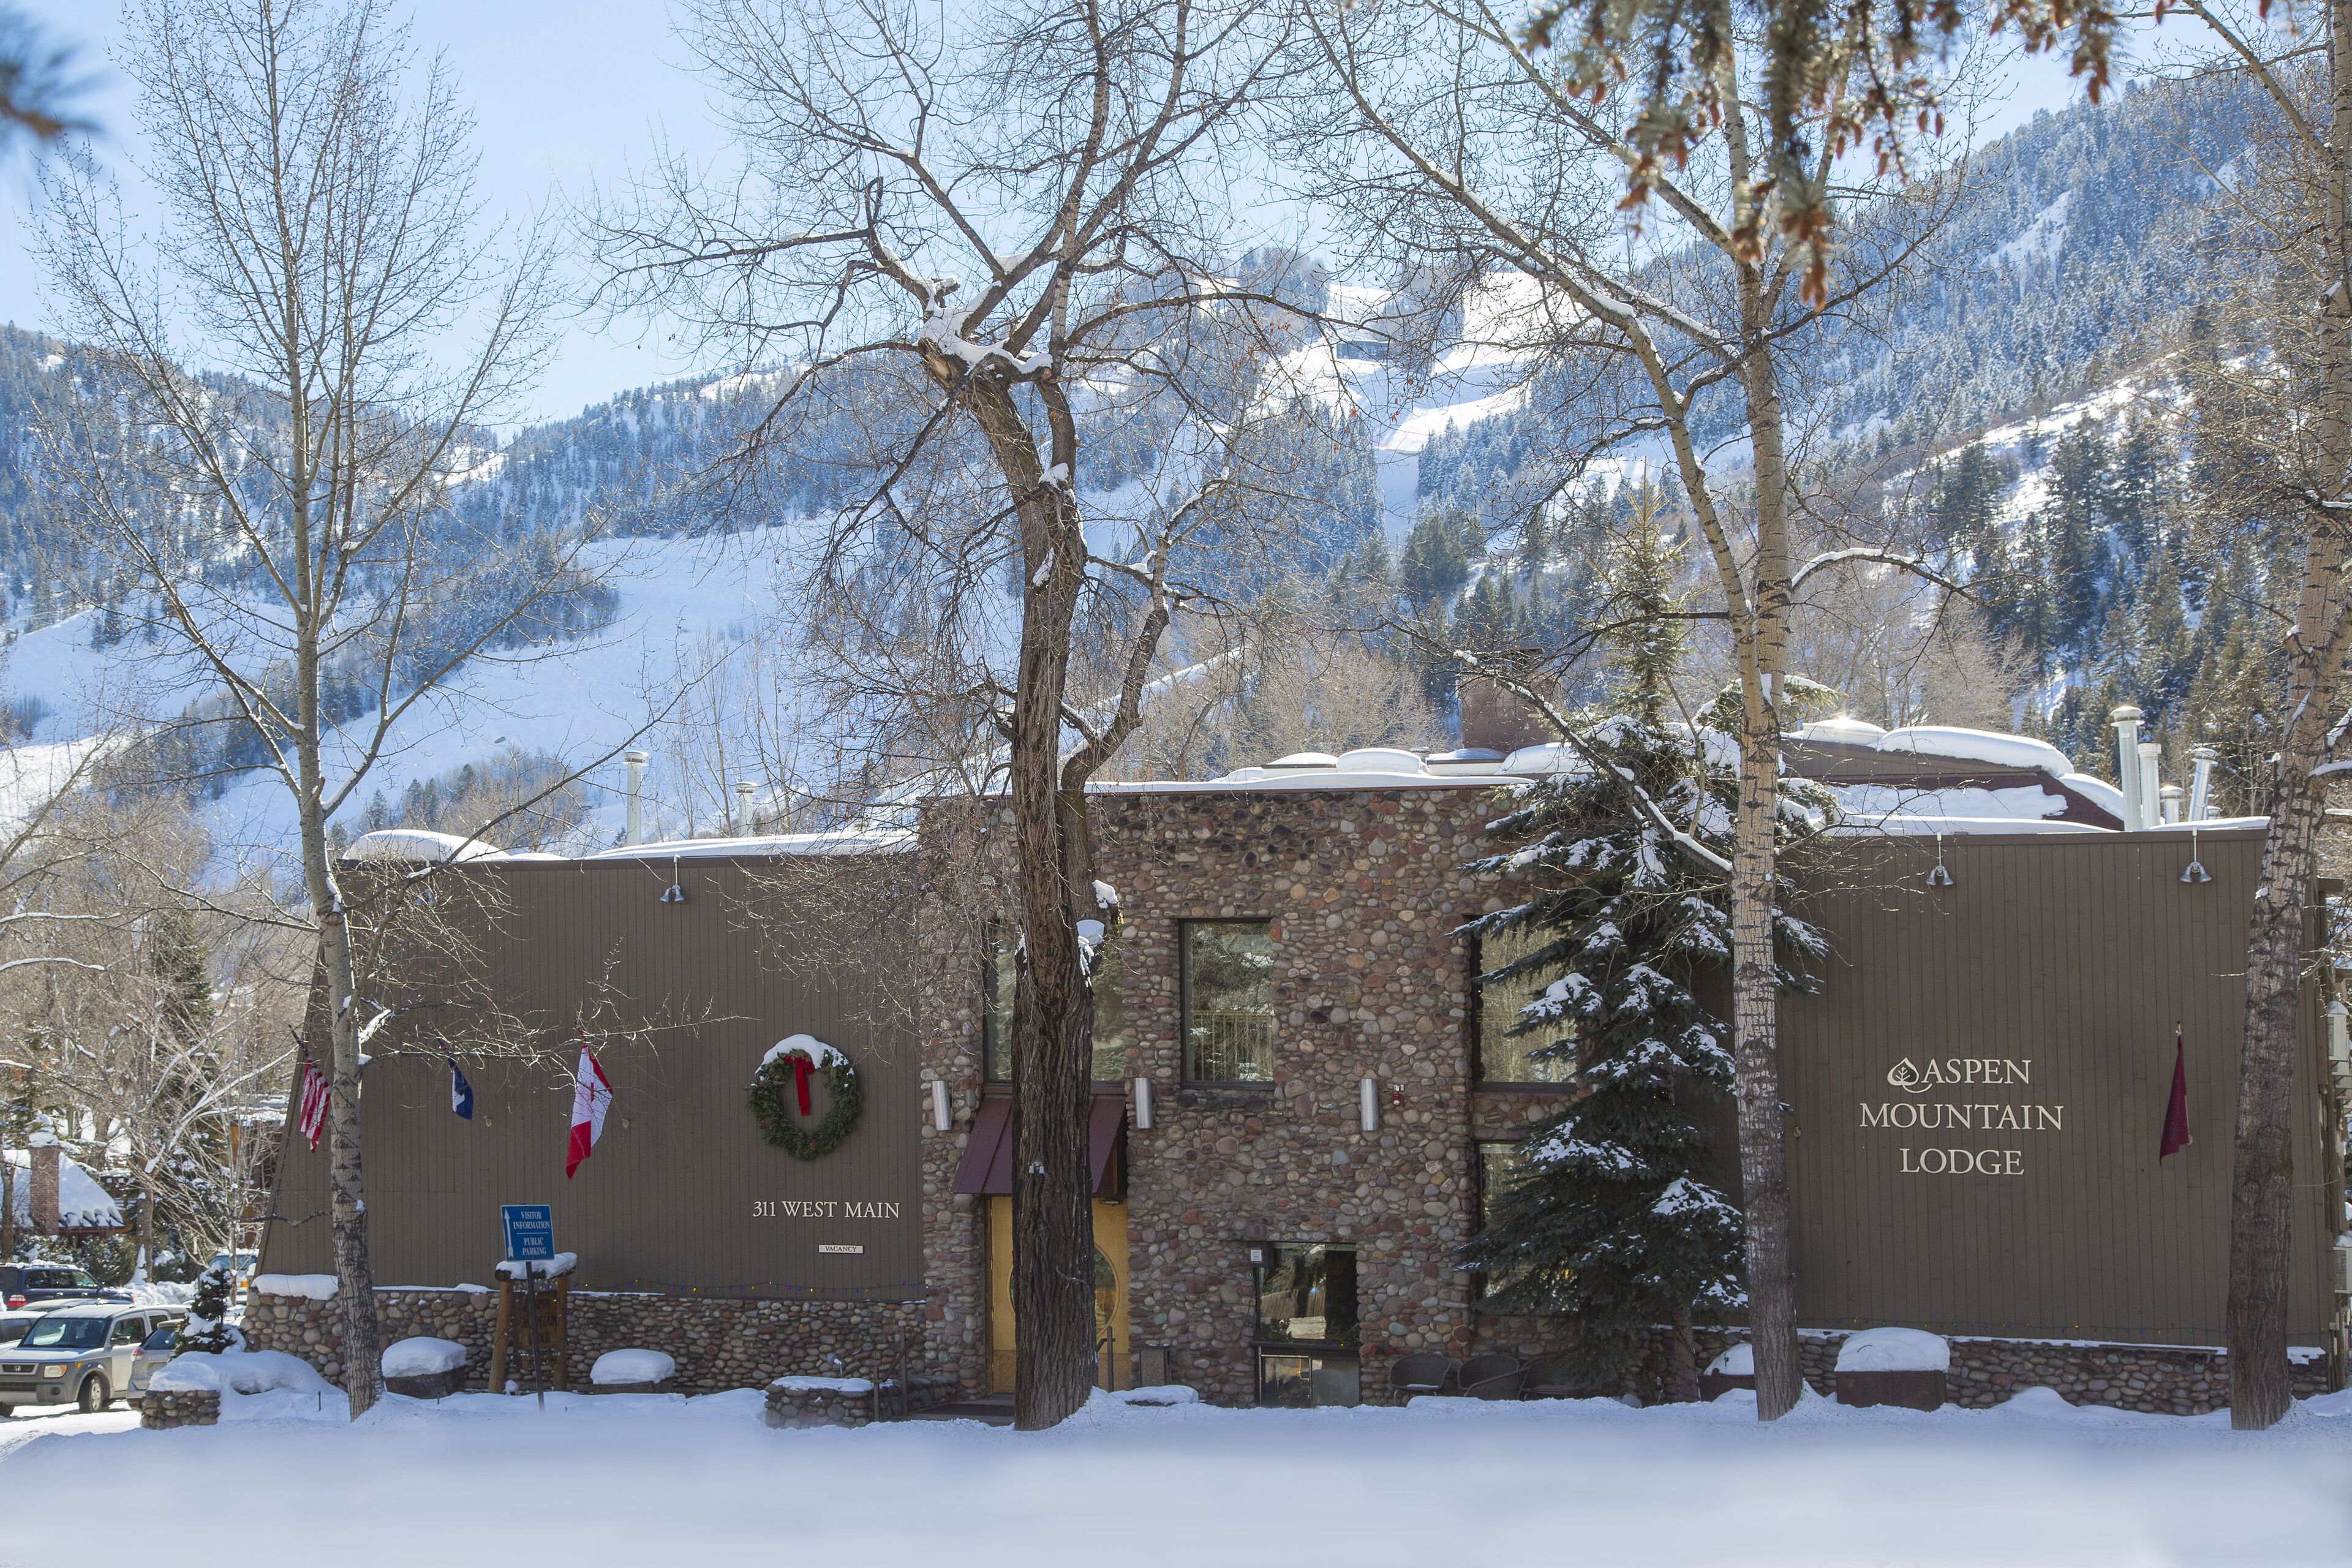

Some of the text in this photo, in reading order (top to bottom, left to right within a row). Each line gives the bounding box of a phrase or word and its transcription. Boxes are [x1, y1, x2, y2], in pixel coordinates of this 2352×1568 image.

[1921, 1058, 2032, 1085] ASPEN
[1860, 1102, 2064, 1131] MOUNTAIN
[1899, 1148, 2024, 1175] LODGE
[753, 1200, 900, 1219] 311 WEST MAIN
[513, 1221, 550, 1229] INFORMATION
[522, 1247, 547, 1256] PARKING
